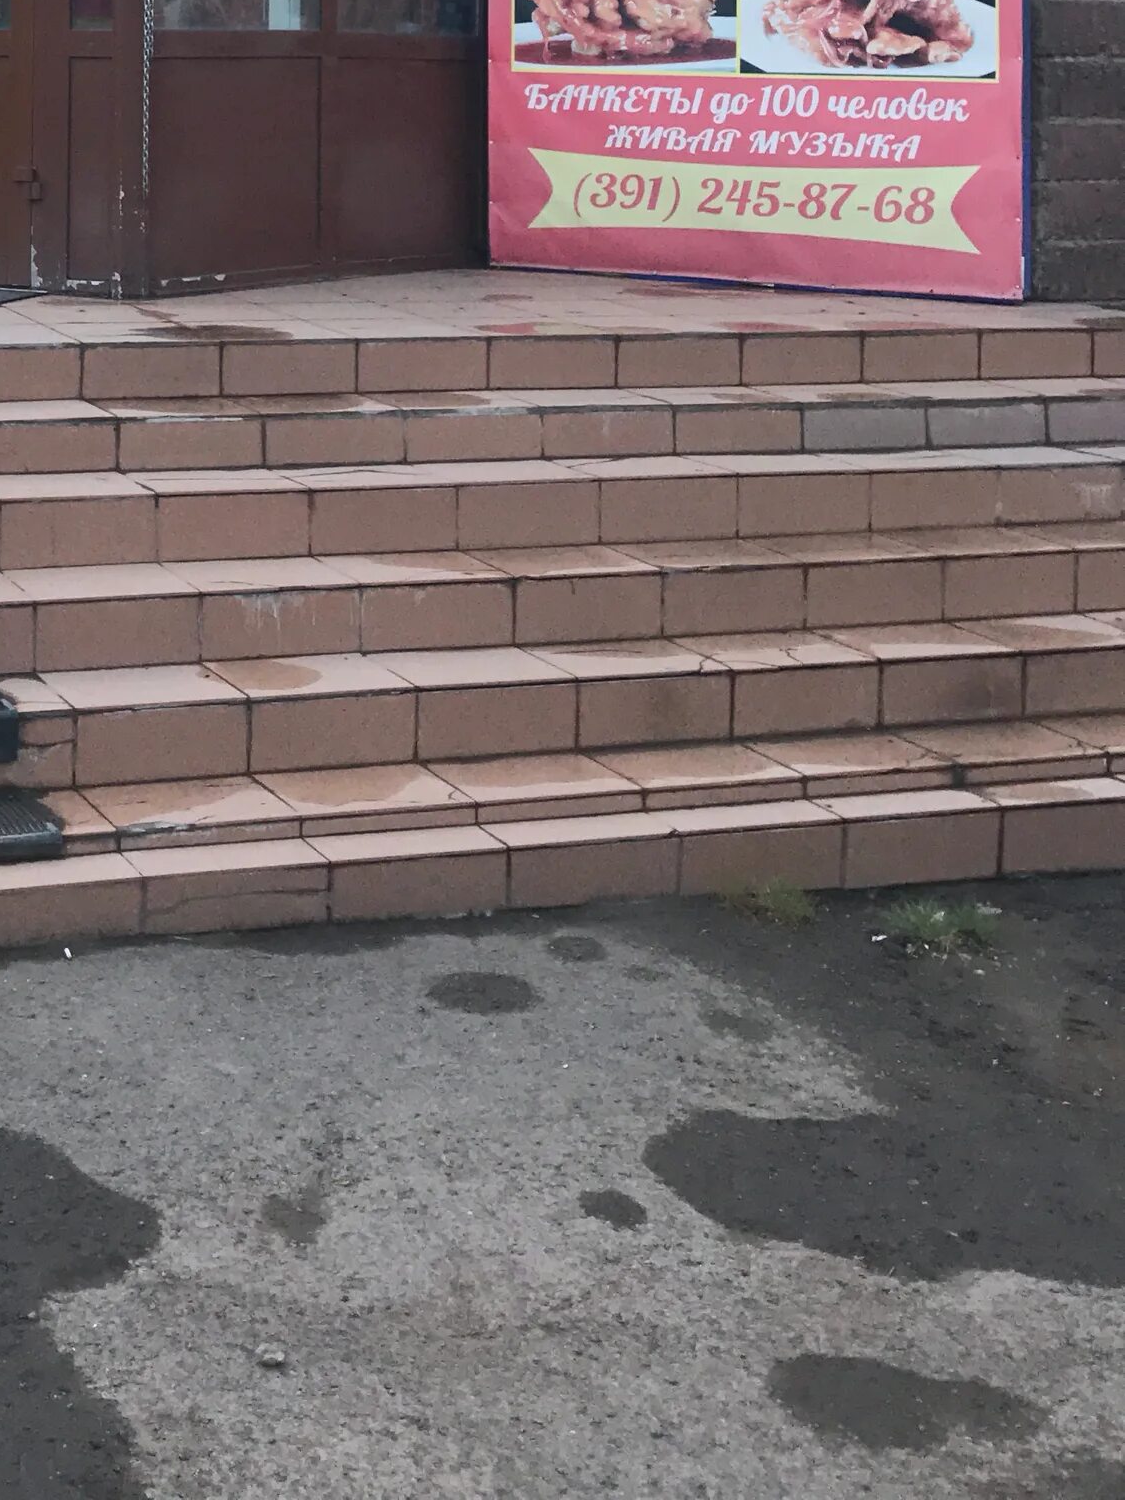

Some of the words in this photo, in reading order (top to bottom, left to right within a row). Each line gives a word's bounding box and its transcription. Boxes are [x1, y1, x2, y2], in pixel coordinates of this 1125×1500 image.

[524, 83, 703, 116] БАНКЕТЫ
[710, 92, 754, 124] до
[758, 84, 820, 118] 100
[827, 88, 970, 123] человек
[604, 125, 742, 153] ЖИВАЯ
[748, 130, 922, 161] МУЗЫКА
[573, 172, 681, 222] (391)
[696, 177, 937, 225] 245-87-68
